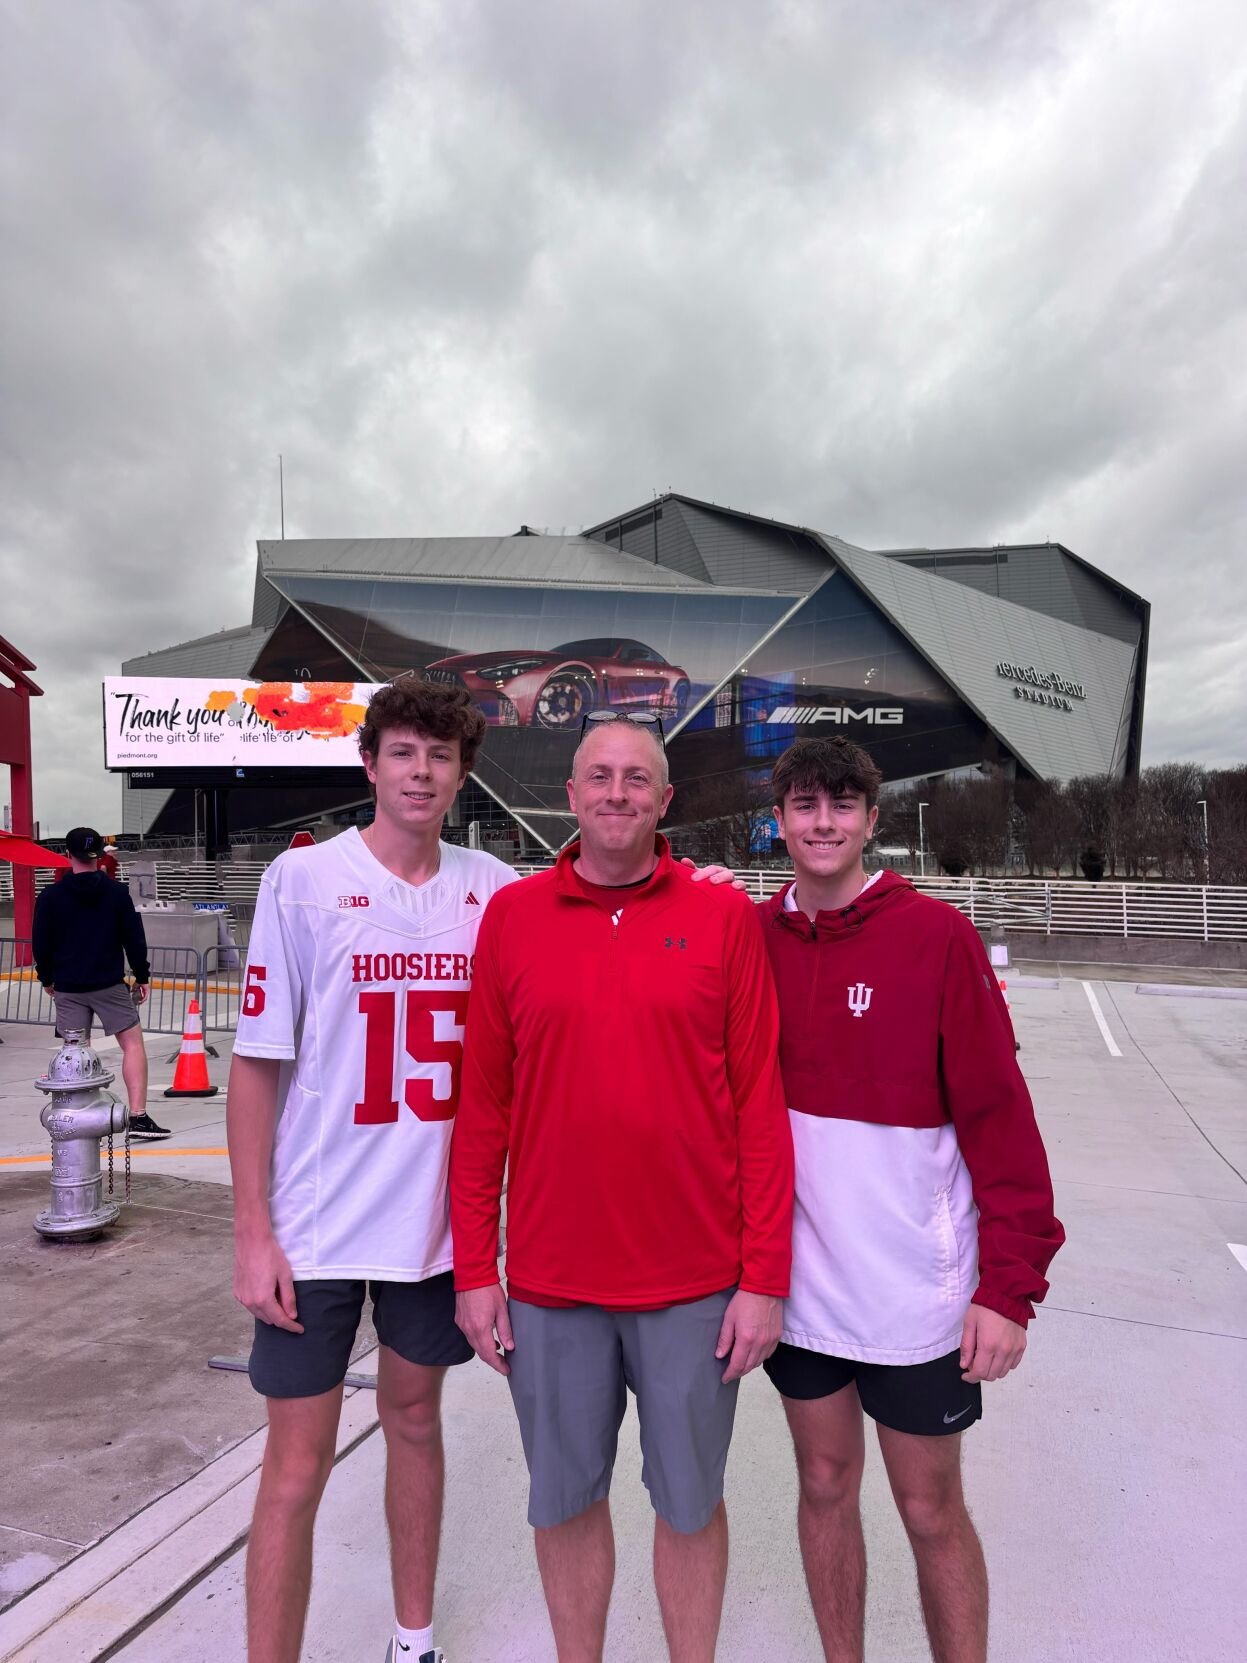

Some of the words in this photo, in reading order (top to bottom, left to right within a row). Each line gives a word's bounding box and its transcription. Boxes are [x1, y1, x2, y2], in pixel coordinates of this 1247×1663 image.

[125, 732, 141, 743] for
[145, 732, 164, 743] the
[166, 732, 186, 745] gift
[188, 732, 201, 743] of
[117, 752, 158, 760] piedmont.org
[354, 990, 471, 1125] 15
